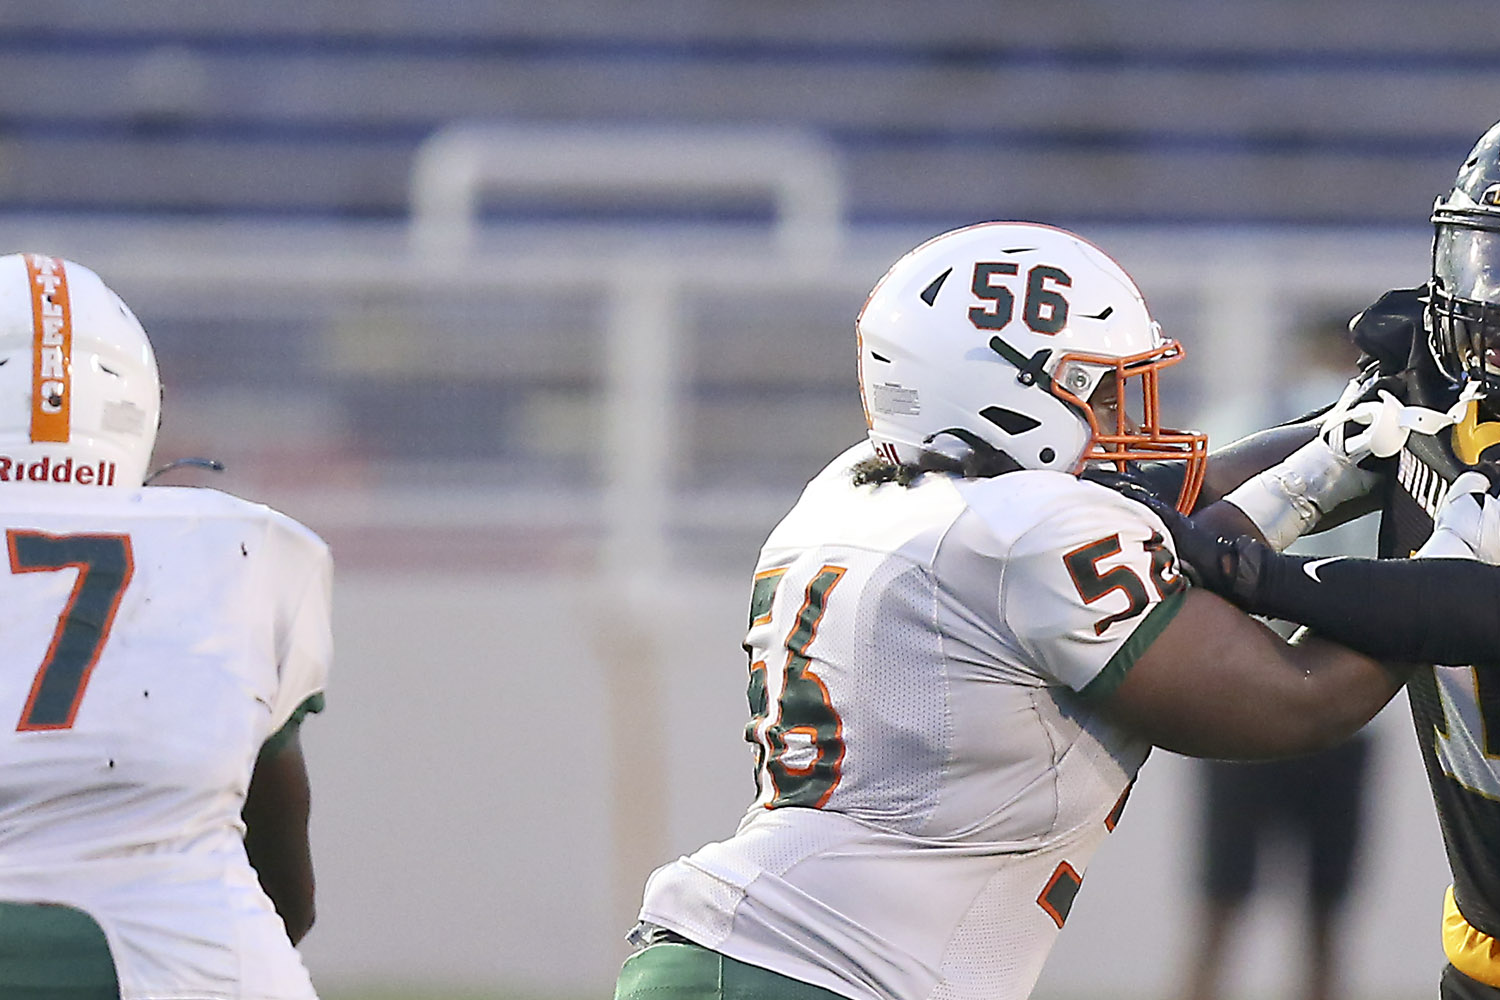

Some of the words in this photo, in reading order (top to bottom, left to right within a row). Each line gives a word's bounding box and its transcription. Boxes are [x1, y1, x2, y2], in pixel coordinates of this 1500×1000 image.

[967, 262, 1072, 334] 56
[0, 455, 117, 488] Riddell
[5, 528, 135, 732] 7
